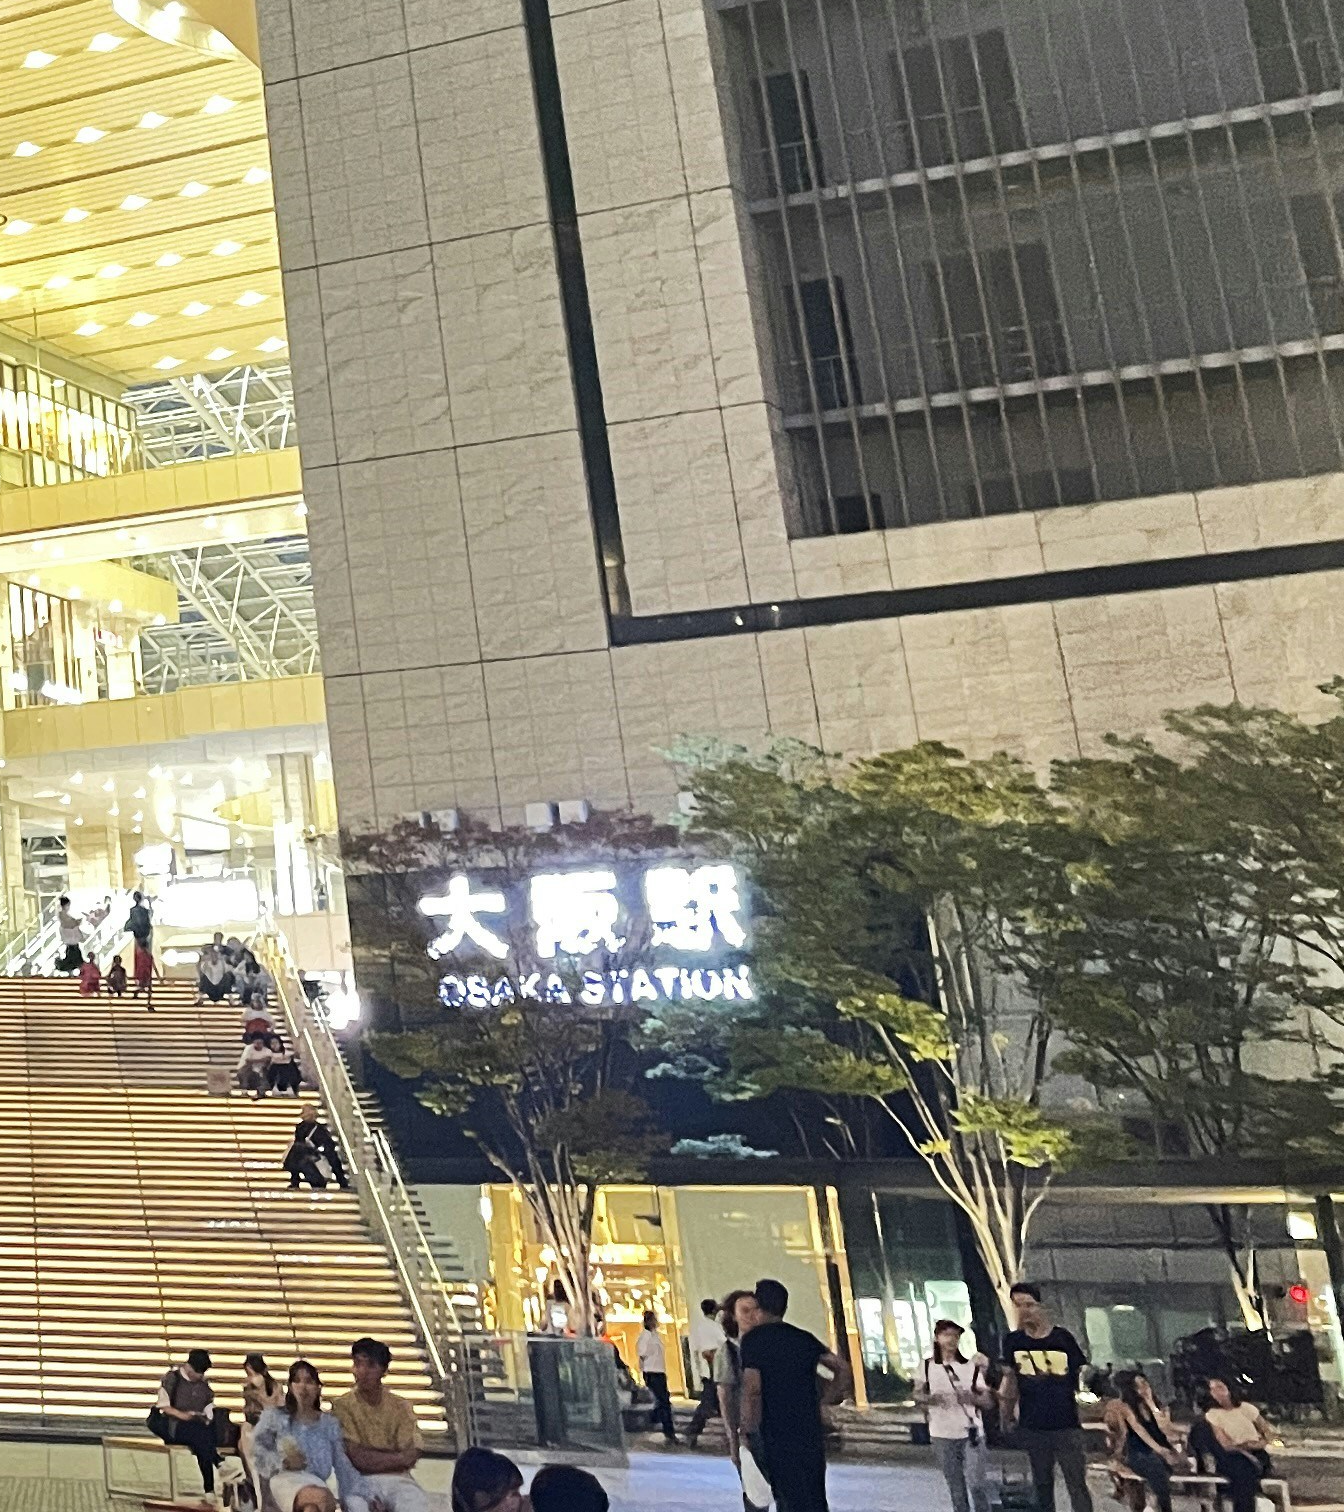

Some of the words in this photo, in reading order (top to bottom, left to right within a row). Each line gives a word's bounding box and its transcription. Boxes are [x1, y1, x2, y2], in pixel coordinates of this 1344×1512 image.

[418, 864, 745, 960] 大阪駅
[439, 972, 572, 1009] OSAKA
[581, 965, 755, 1005] STATION
